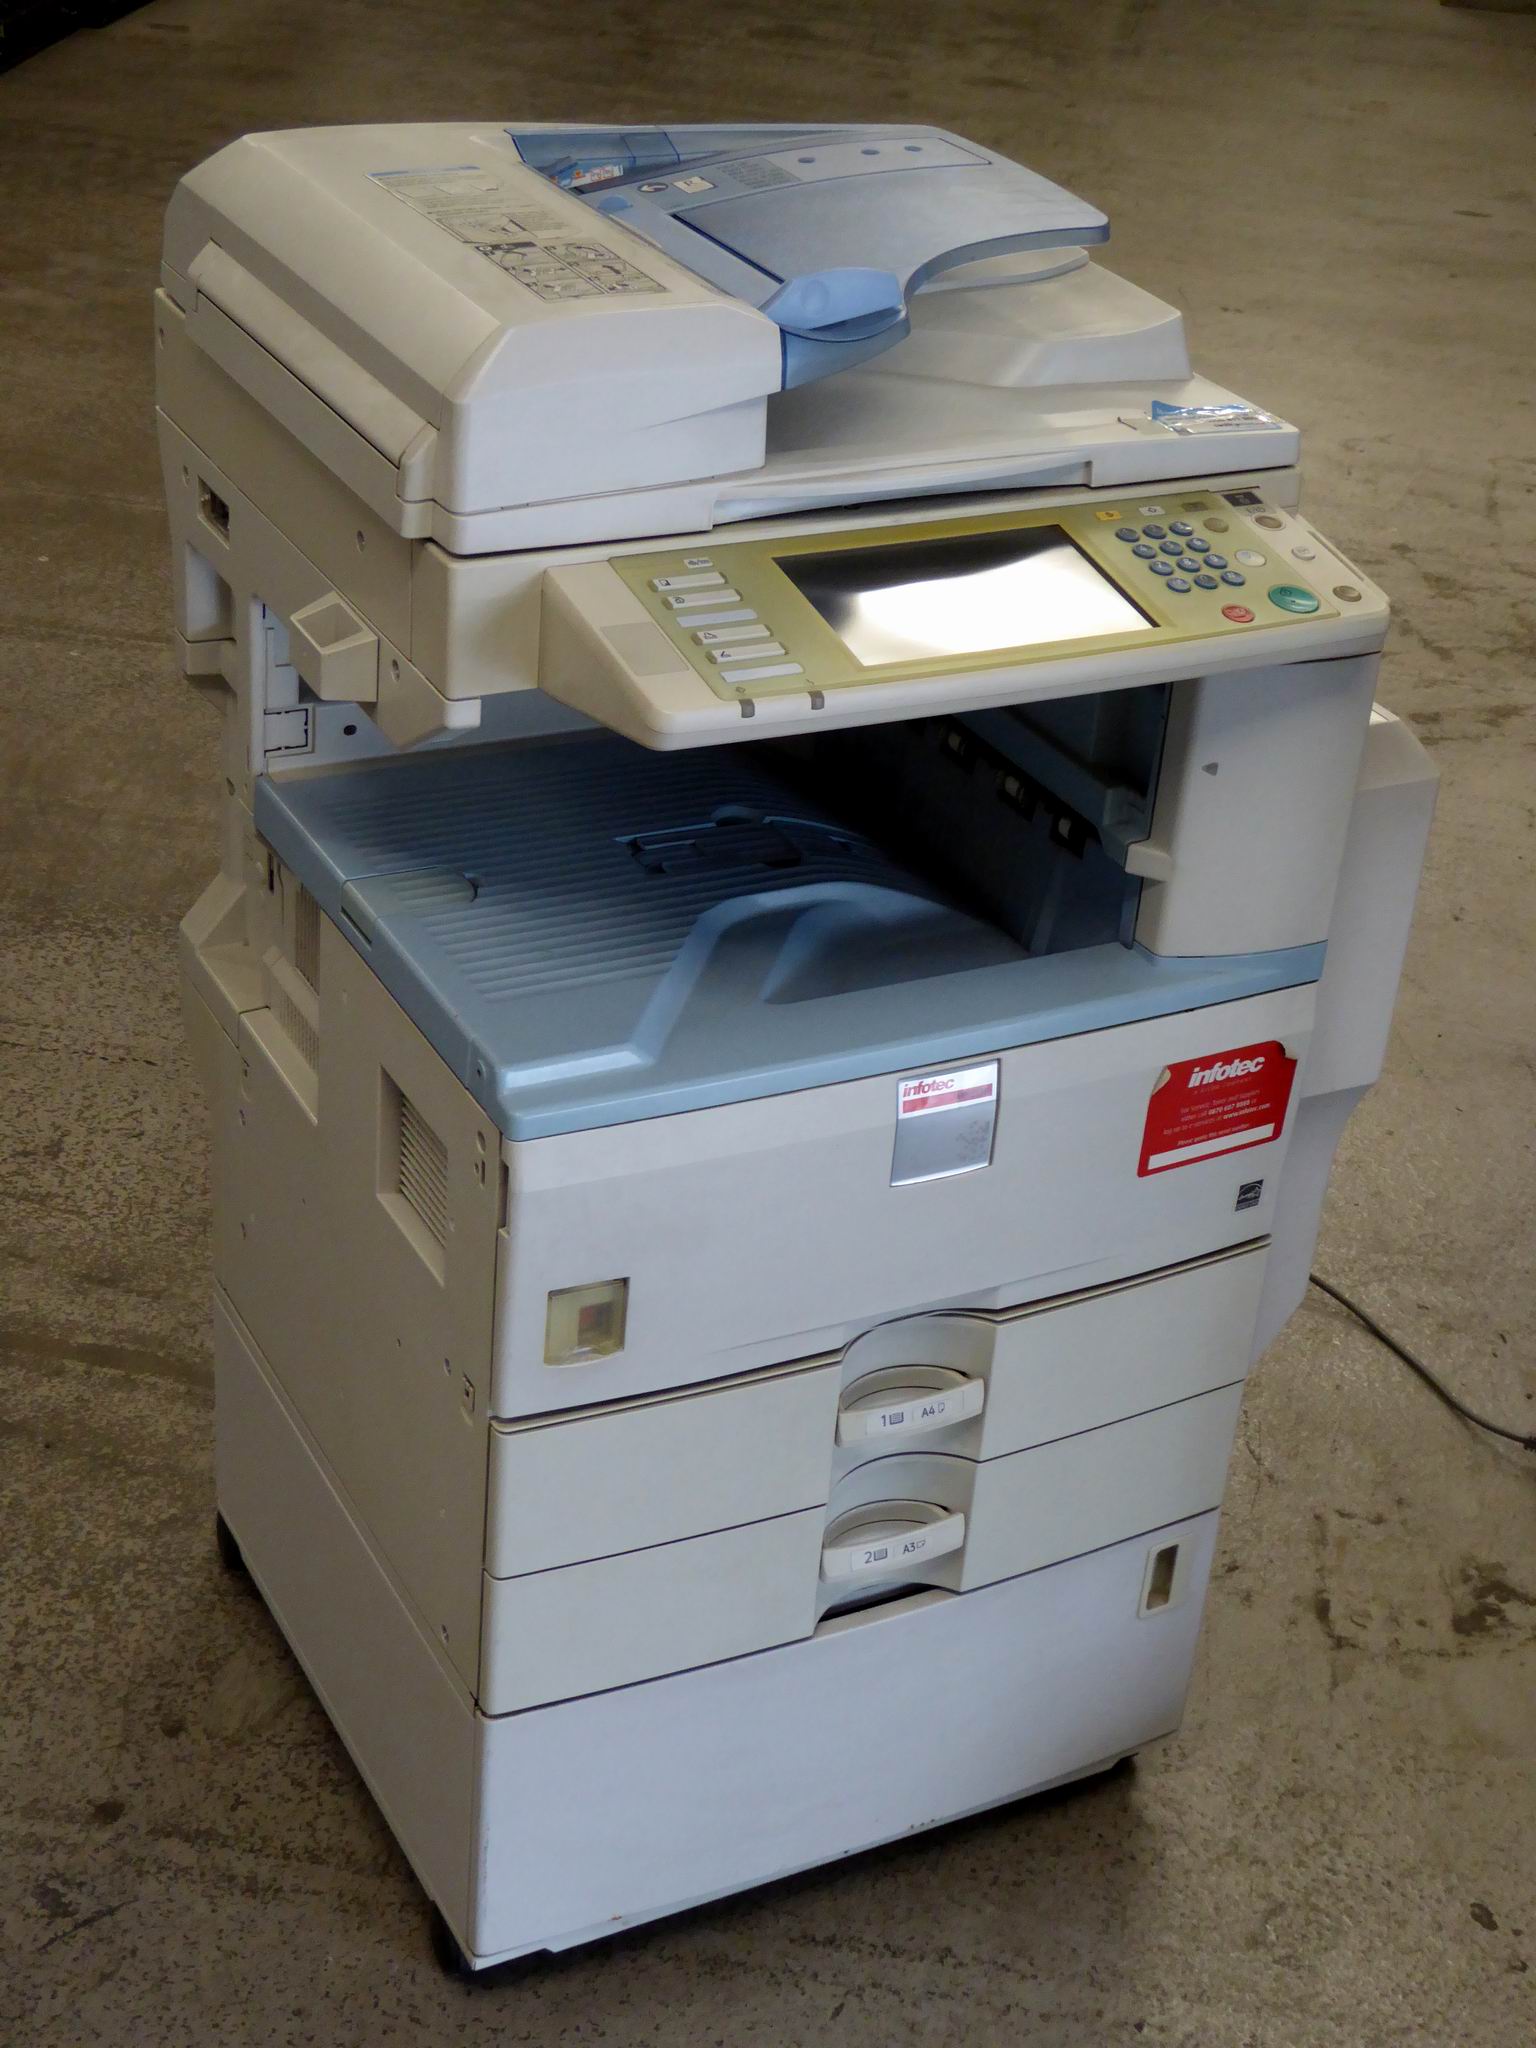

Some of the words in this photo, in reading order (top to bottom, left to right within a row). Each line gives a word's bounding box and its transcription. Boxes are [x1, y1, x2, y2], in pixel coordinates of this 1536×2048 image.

[1187, 1056, 1265, 1089] infotec
[903, 1079, 955, 1098] infotec
[881, 1414, 887, 1427] 1
[921, 1405, 936, 1419] A4
[864, 1550, 872, 1564] 2
[902, 1542, 917, 1555] A3
